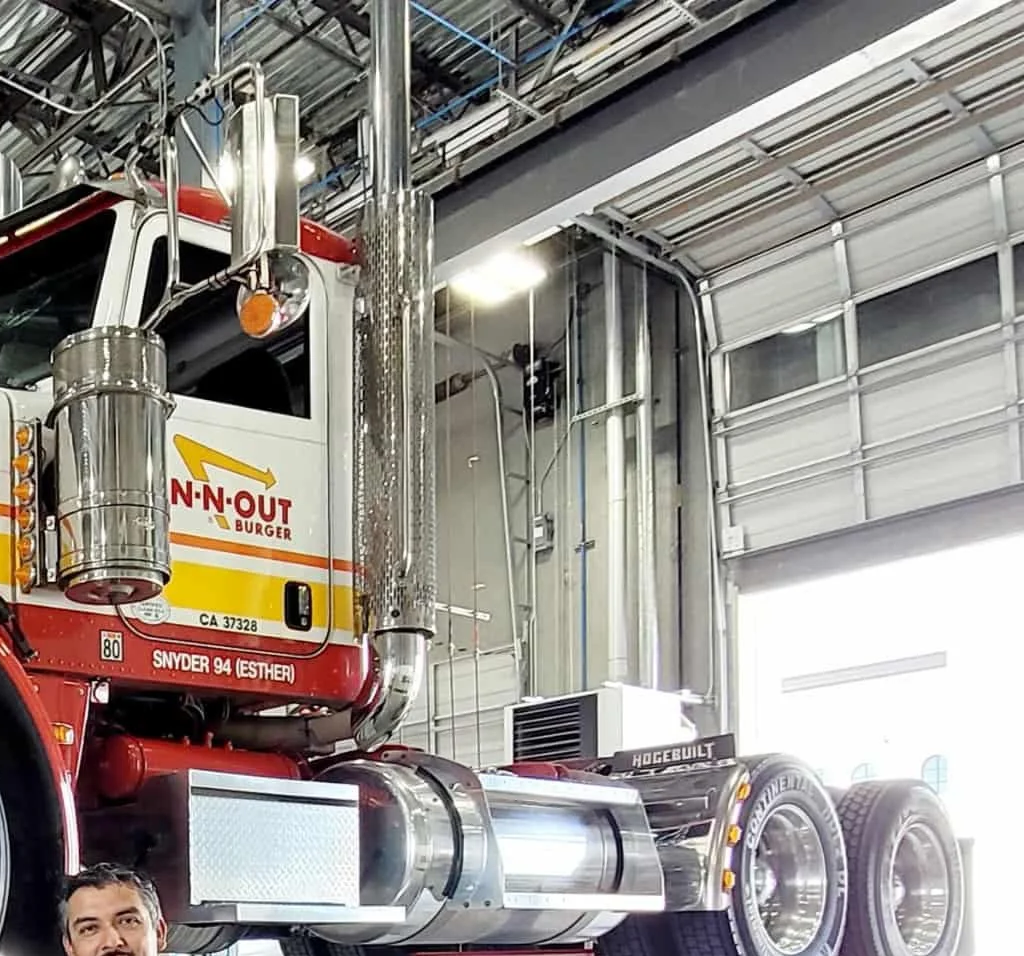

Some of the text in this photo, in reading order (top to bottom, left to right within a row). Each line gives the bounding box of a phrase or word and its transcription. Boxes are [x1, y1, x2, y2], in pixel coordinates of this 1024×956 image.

[171, 478, 292, 525] N-N-OUT
[235, 519, 293, 540] BURGER
[199, 613, 258, 633] CA 37328
[103, 638, 121, 659] 80
[152, 649, 296, 685] SNYDER 94 (ESTHER)
[632, 742, 716, 768] HOGEBUILT
